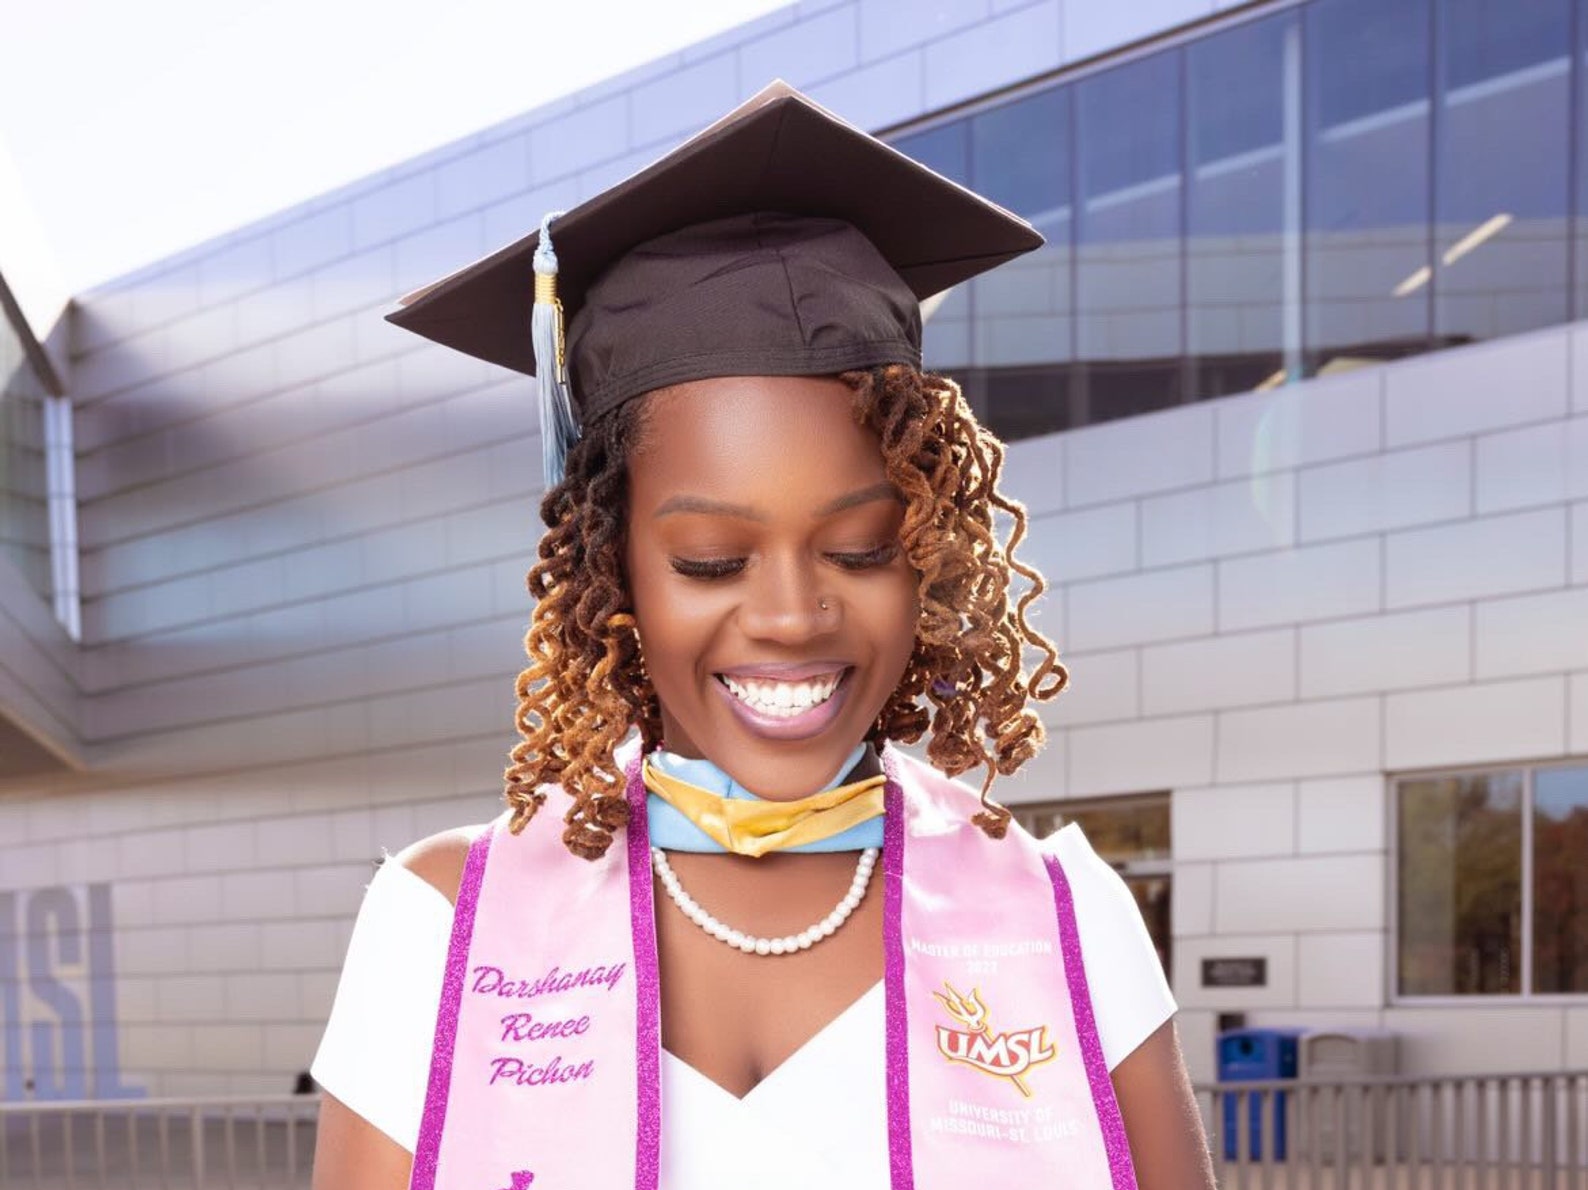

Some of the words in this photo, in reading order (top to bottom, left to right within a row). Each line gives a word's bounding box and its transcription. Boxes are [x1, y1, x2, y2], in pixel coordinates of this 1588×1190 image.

[471, 963, 626, 998] Darshanay
[500, 1013, 590, 1041] Renee
[935, 1024, 1055, 1076] UMSL
[490, 1056, 594, 1086] Pichon
[948, 1098, 1030, 1125] UNIVERSITY
[1035, 1105, 1054, 1122] OF
[1034, 1118, 1080, 1142] LOUIS
